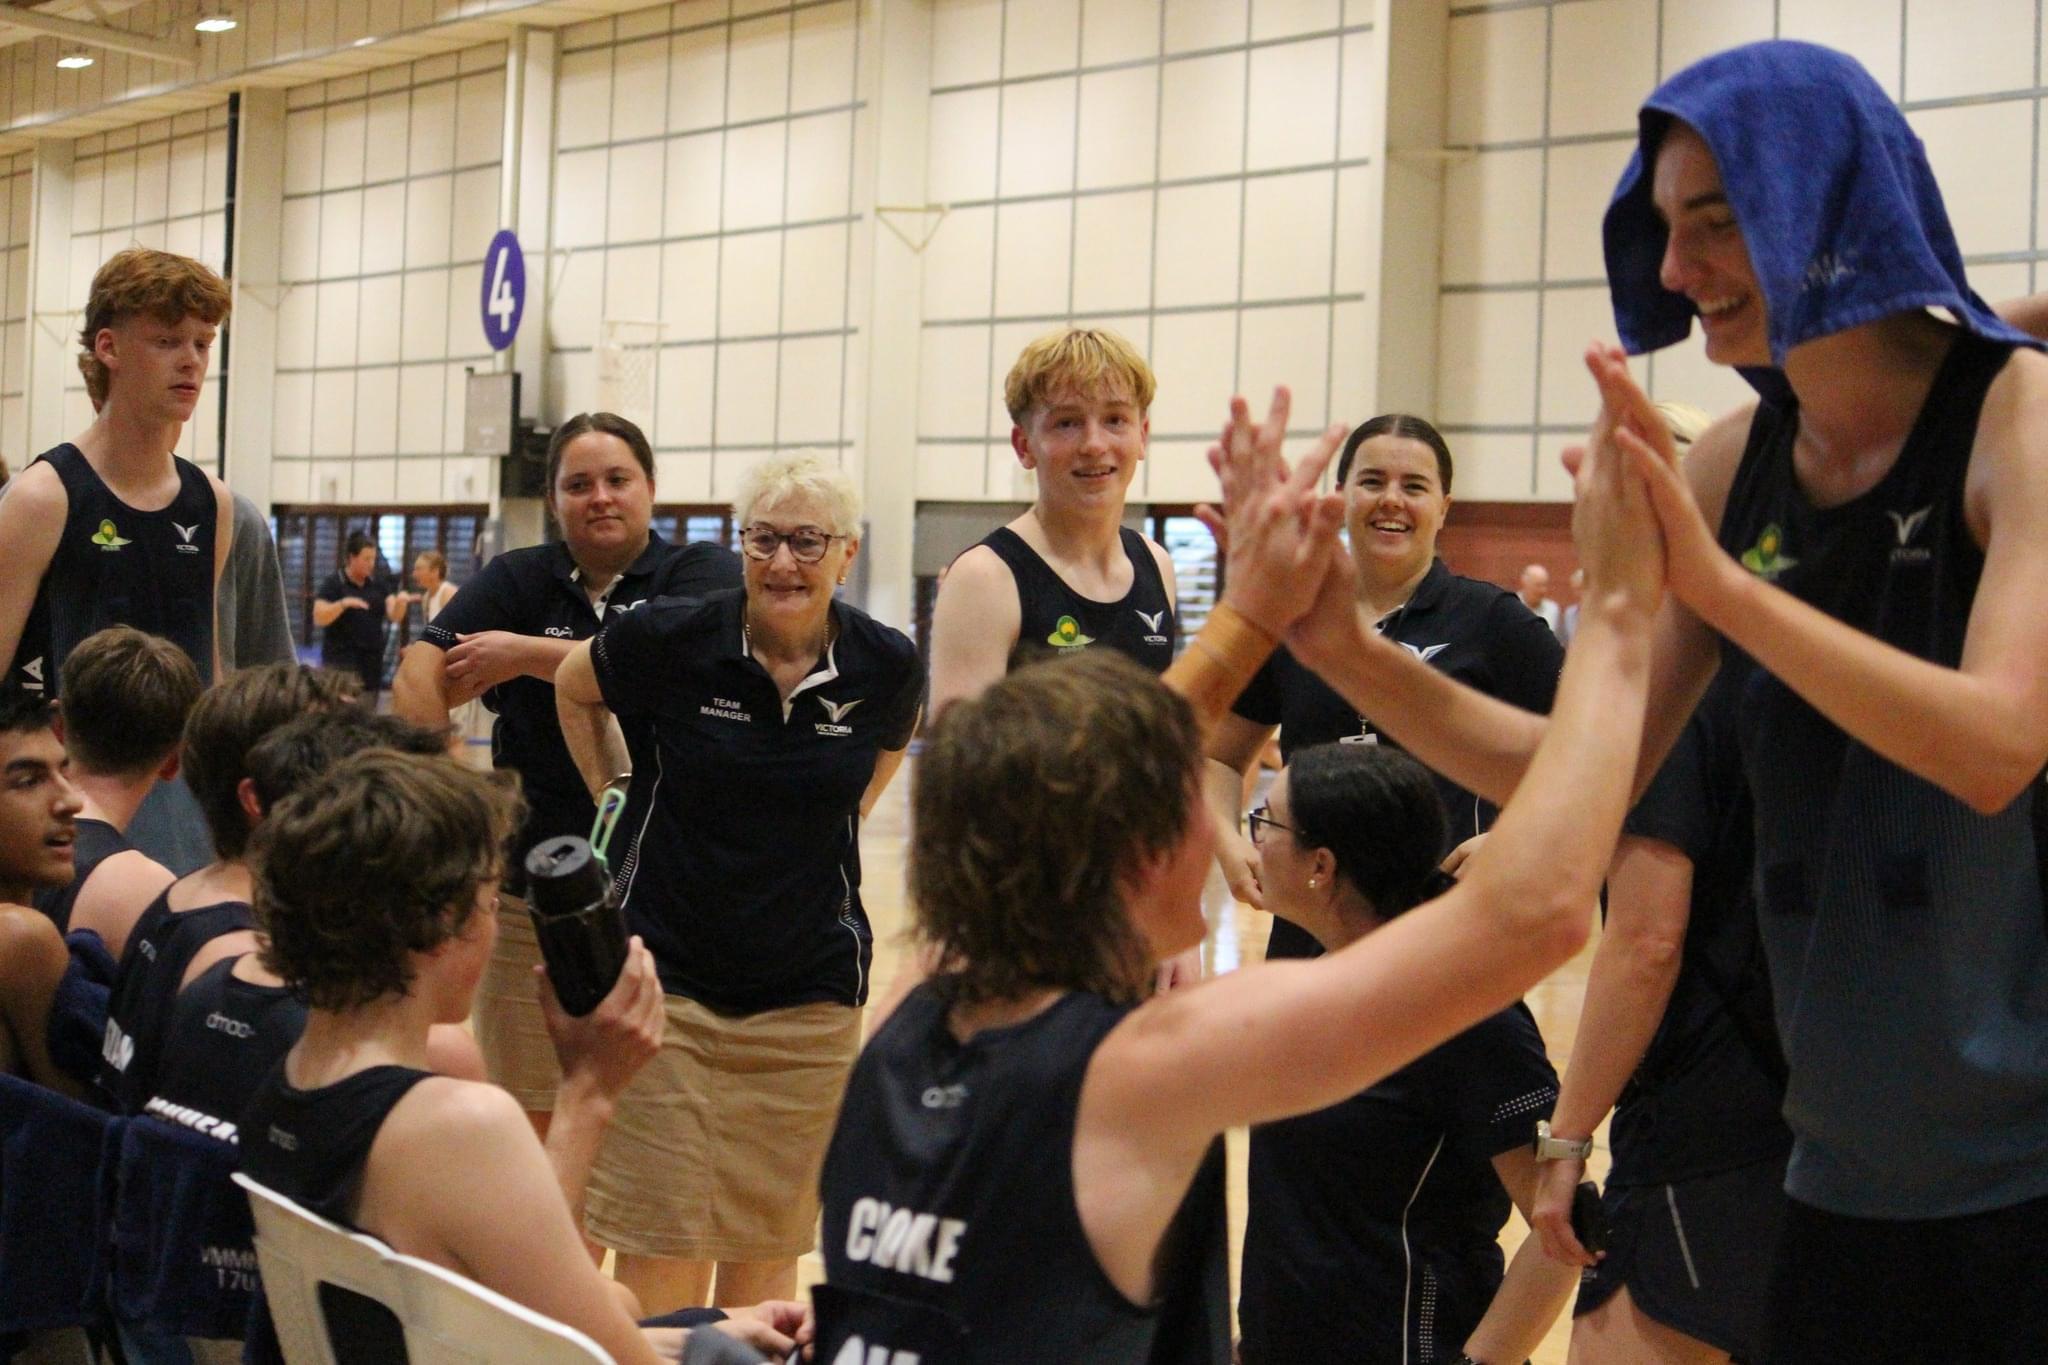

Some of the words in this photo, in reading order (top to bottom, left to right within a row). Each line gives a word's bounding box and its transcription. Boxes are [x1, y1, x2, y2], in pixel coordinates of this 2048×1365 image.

[488, 247, 516, 333] 4
[712, 697, 741, 710] TEAM
[700, 706, 752, 722] MANAGER
